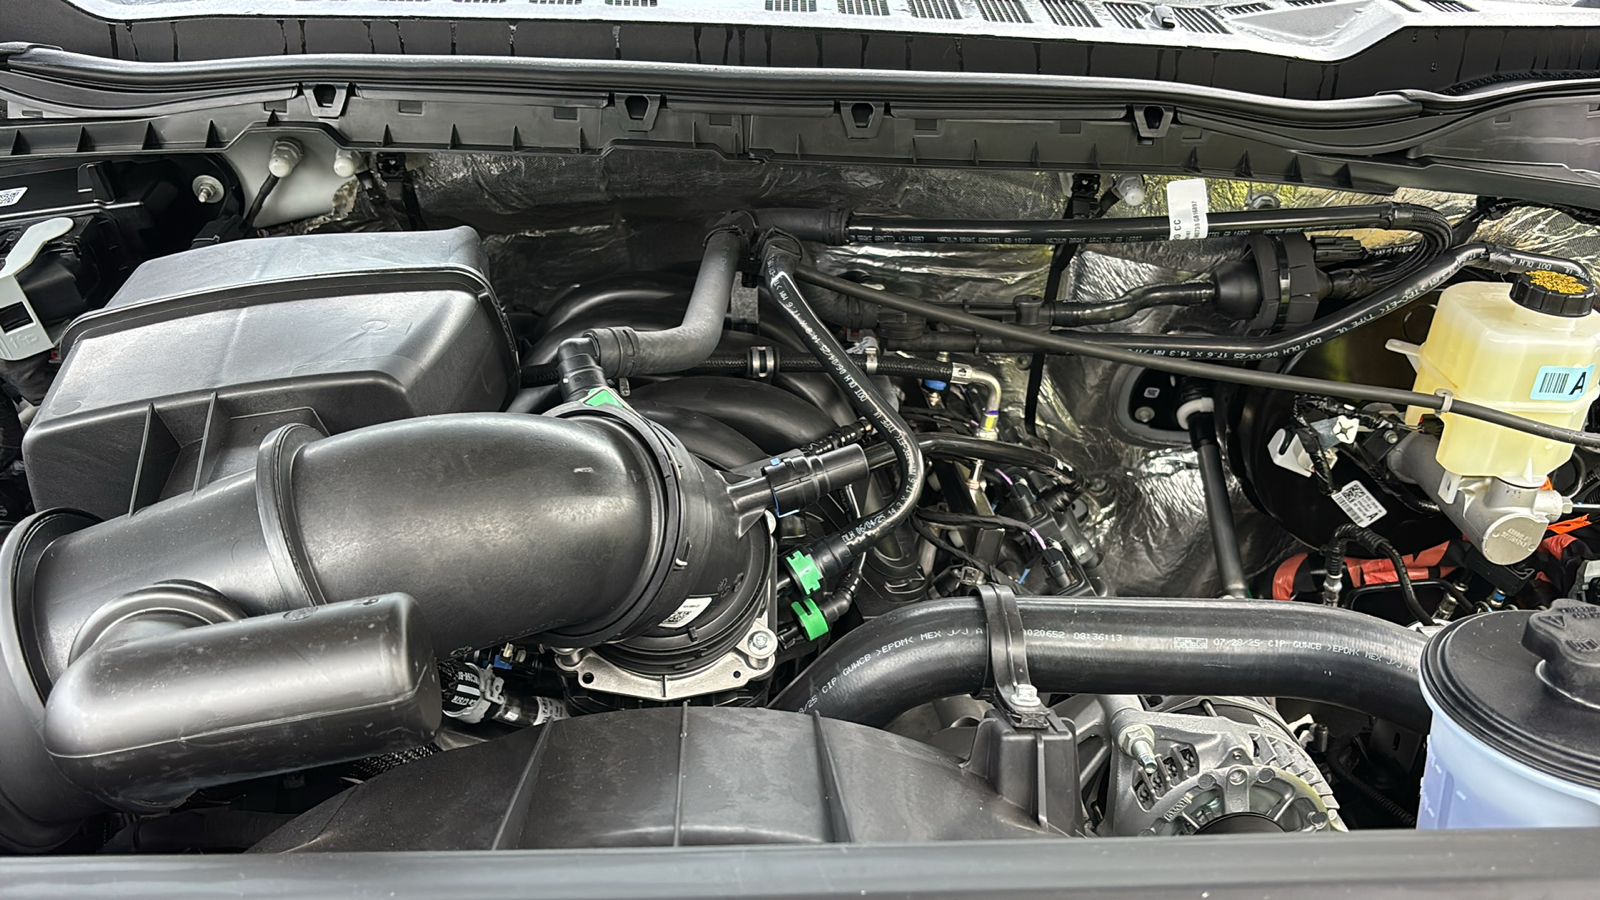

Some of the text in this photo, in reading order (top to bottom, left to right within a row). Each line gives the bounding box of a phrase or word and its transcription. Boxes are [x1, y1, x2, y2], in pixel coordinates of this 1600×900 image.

[1518, 259, 1535, 268] DLH
[1536, 262, 1552, 271] DOT
[1305, 337, 1323, 349] DOT
[1169, 350, 1190, 359] 14.3
[1195, 351, 1202, 359] X
[1206, 351, 1228, 359] 17.6
[1233, 351, 1279, 360] 06/03/25
[1282, 344, 1301, 356] DLH
[819, 344, 847, 375] 06/04/25
[843, 374, 857, 388] DLH
[1568, 371, 1587, 396] A
[854, 388, 868, 402] DOT
[1366, 512, 1379, 522] A
[1073, 631, 1123, 642] 08:36:13
[1267, 639, 1286, 648] CIP
[1364, 651, 1382, 662] MEX
[821, 677, 837, 694] CIP
[875, 636, 914, 657] >EPDM<
[920, 630, 942, 641] MEX
[975, 627, 983, 635] A
